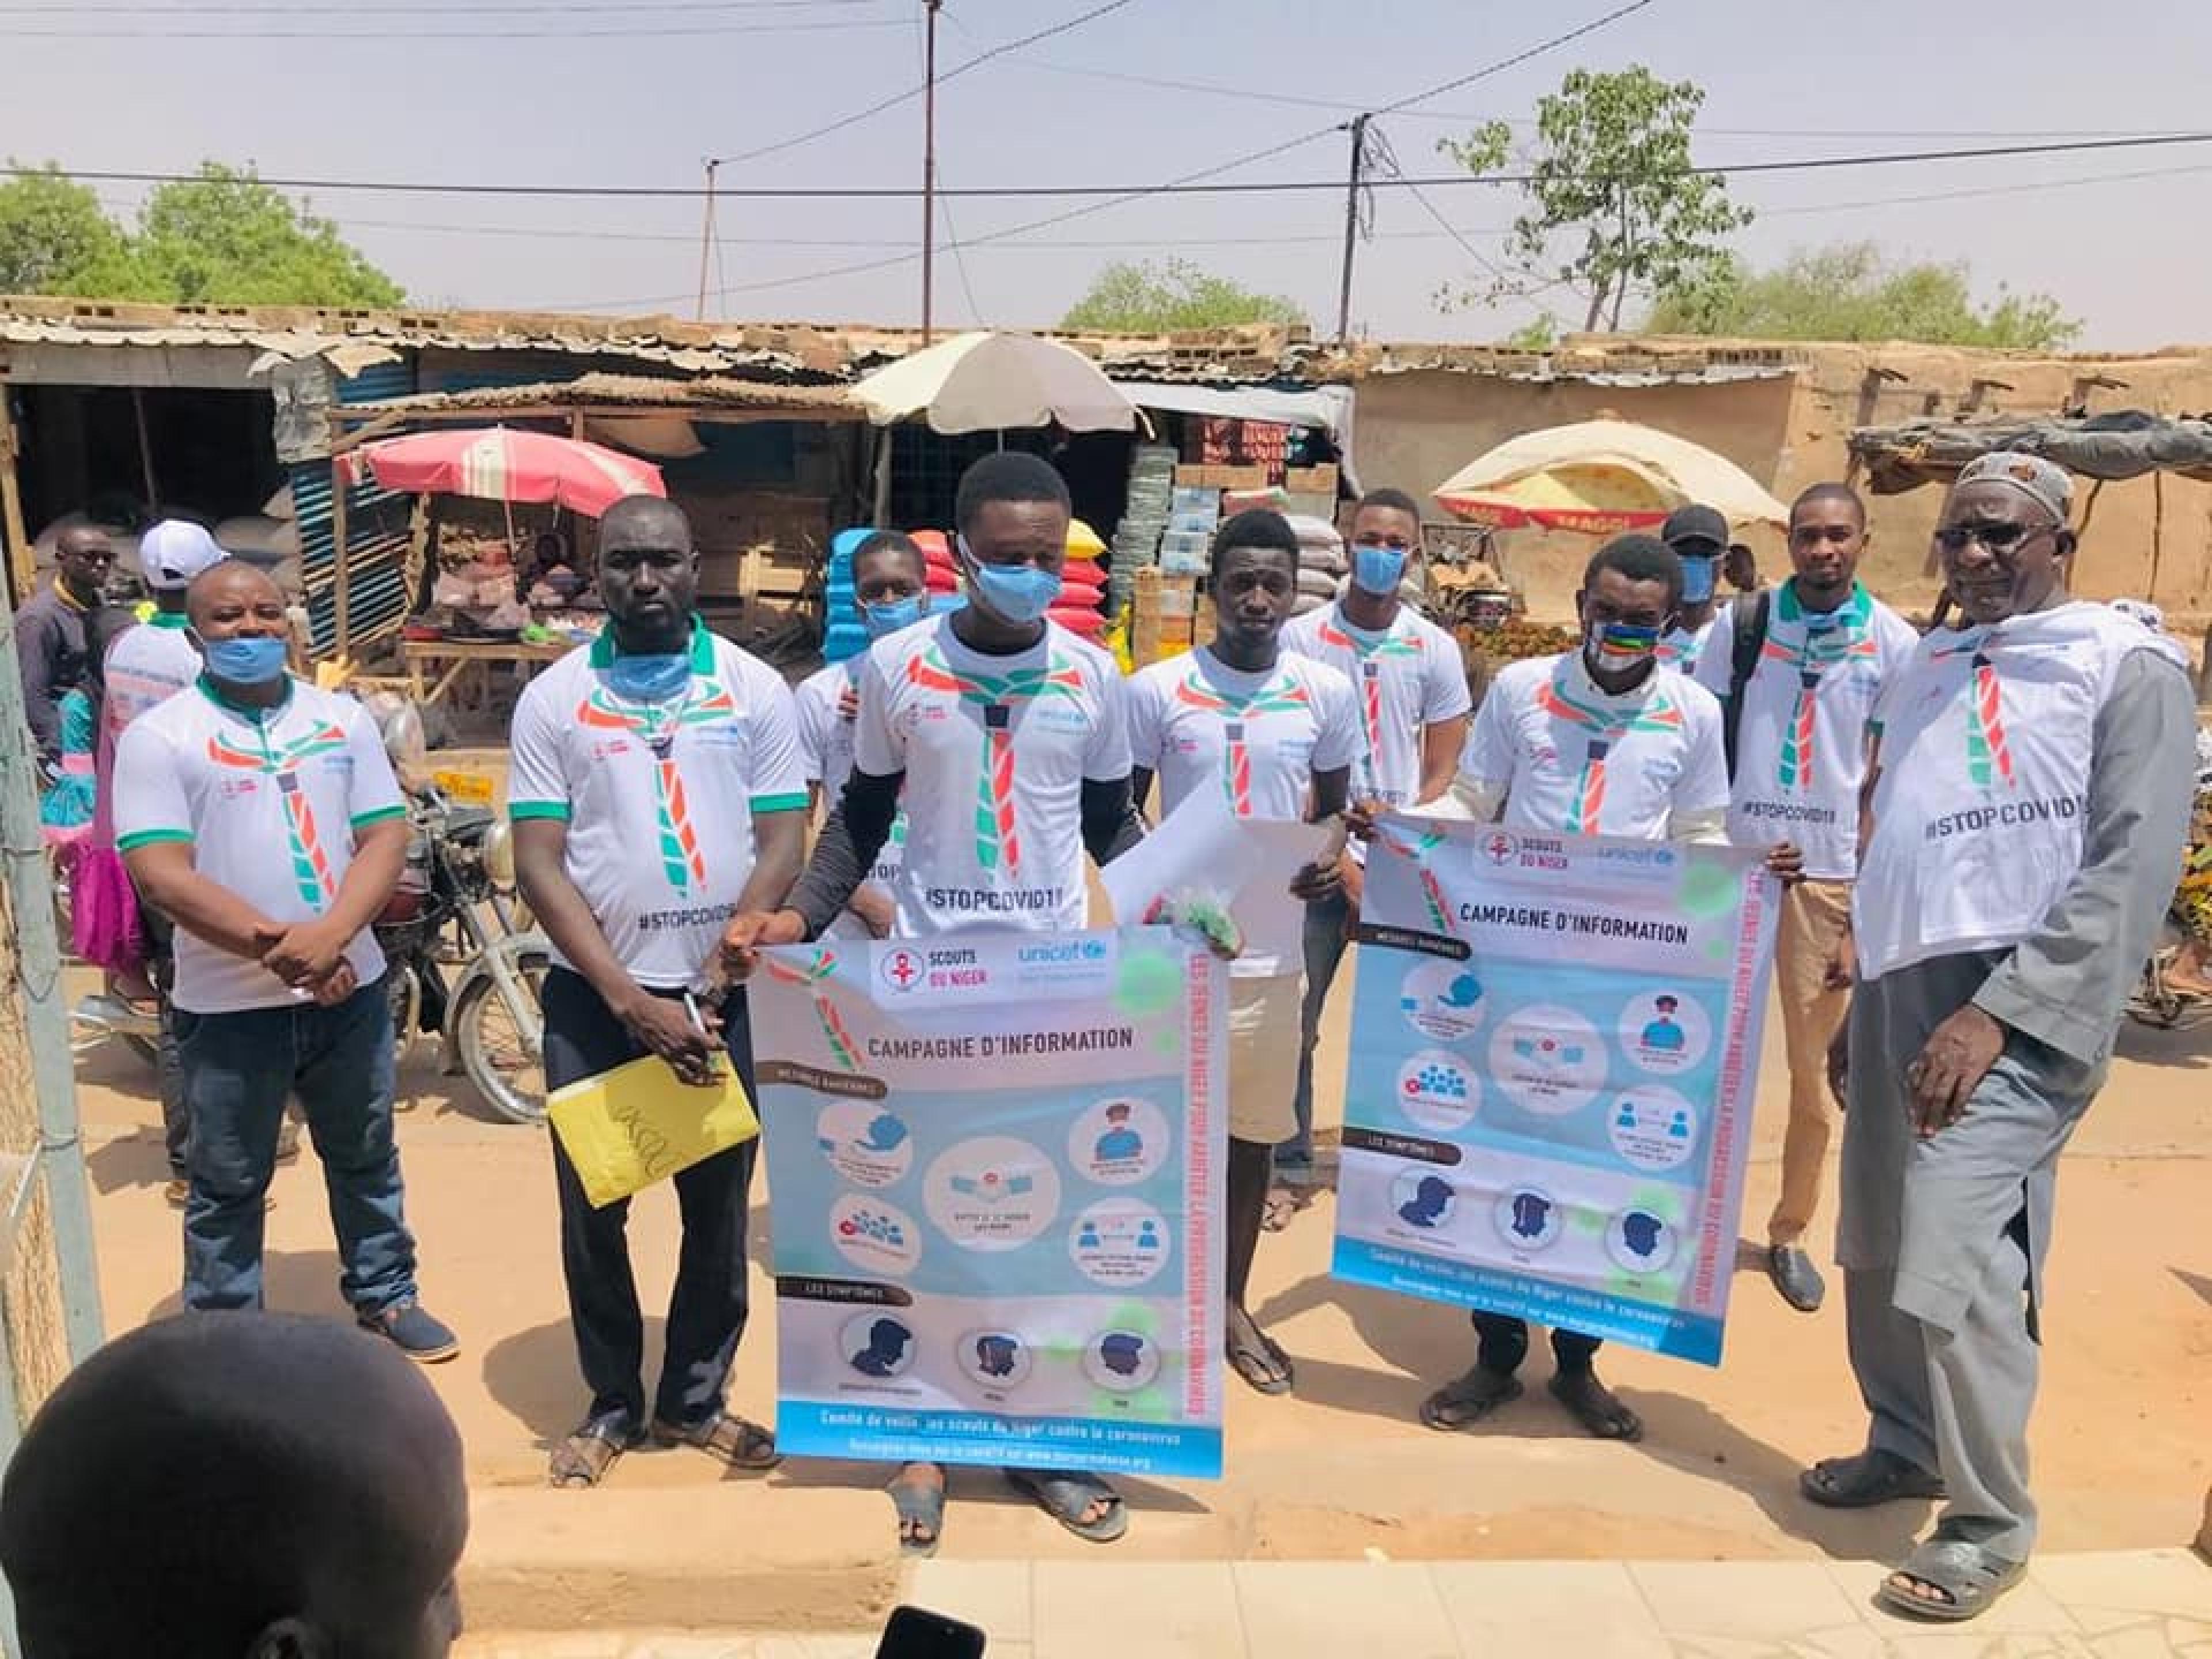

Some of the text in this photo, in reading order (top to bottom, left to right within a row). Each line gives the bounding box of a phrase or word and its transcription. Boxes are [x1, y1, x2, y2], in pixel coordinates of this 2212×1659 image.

[1557, 515, 1630, 533] MAGGI
[1597, 843, 1652, 861] unicef
[1460, 903, 1689, 945] CAMPAGNE D'INFORMATION
[927, 949, 976, 965] SCOUTS
[1018, 941, 1080, 962] unicef
[929, 969, 988, 987] DU NIGER
[868, 1027, 1132, 1060] CAMPAGNE D'INFORMATION
